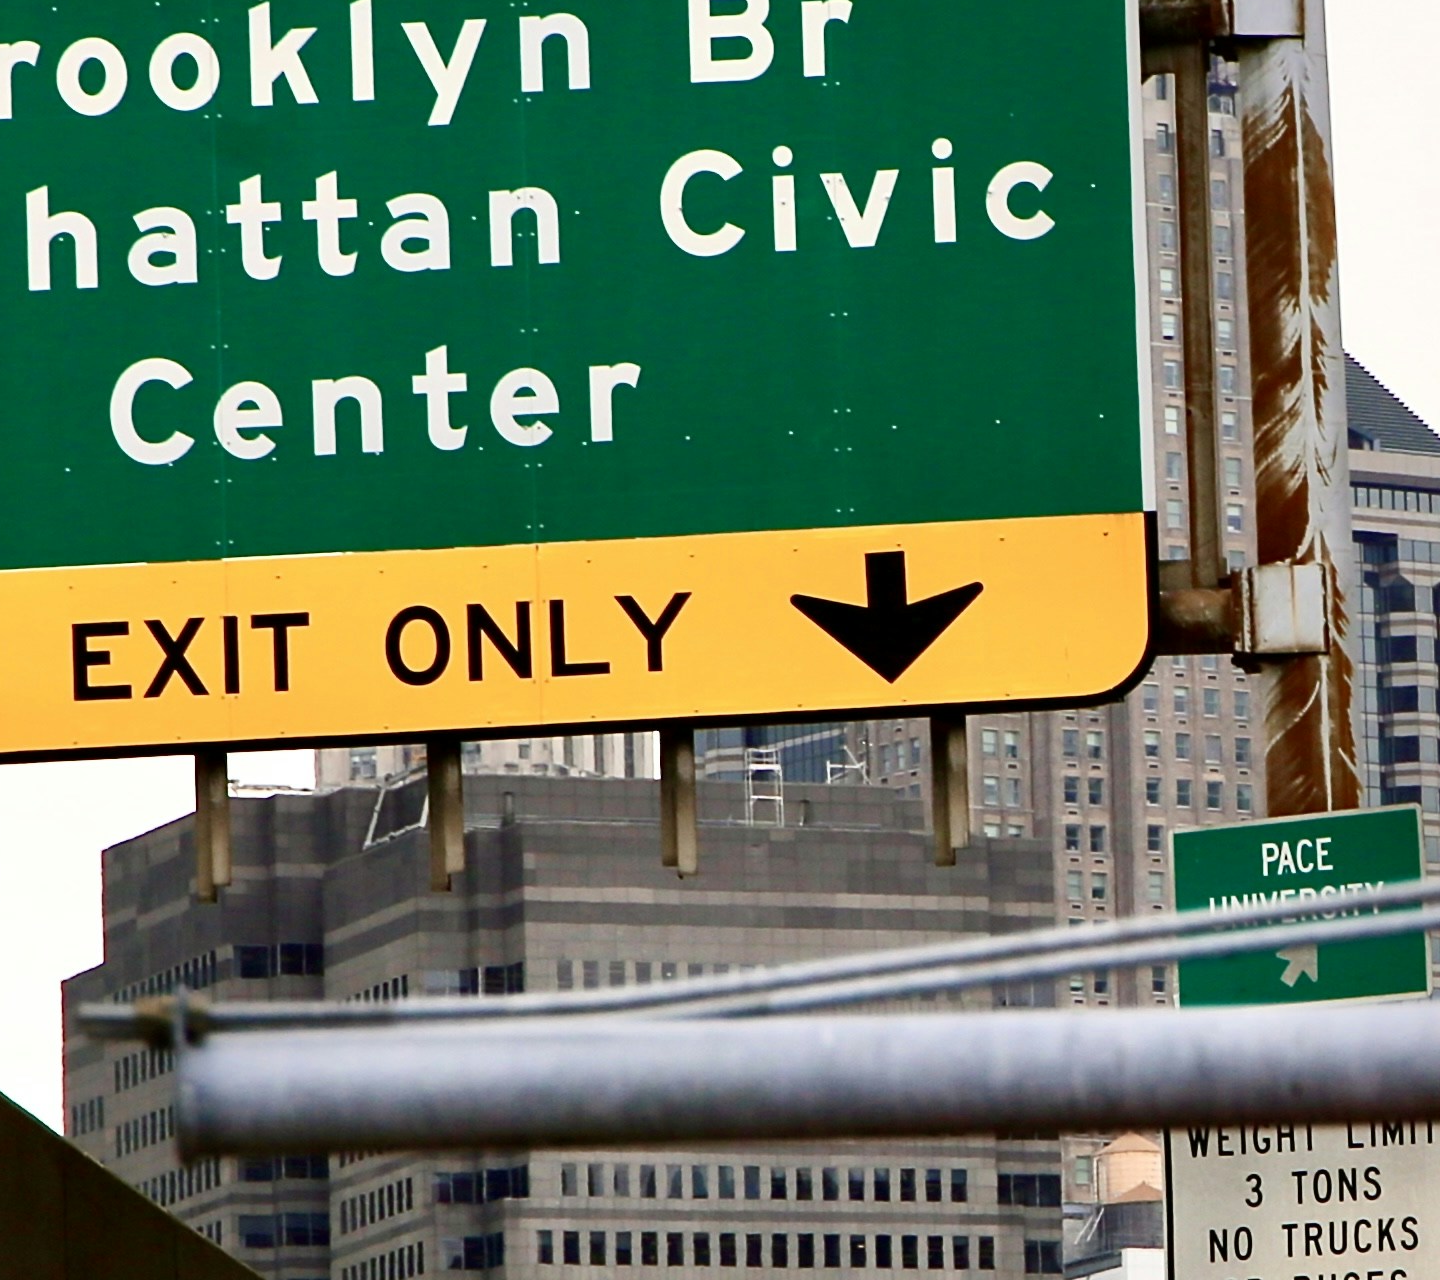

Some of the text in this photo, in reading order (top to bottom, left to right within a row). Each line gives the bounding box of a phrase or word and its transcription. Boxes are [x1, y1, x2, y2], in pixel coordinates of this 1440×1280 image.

[659, 137, 1057, 258] Civic
[109, 344, 643, 467] Center
[71, 591, 694, 703] EXIT ONLY
[1261, 836, 1334, 877] PACE
[1244, 1166, 1382, 1208] 3 TONS
[1209, 1216, 1420, 1264] NO TRUCKS
